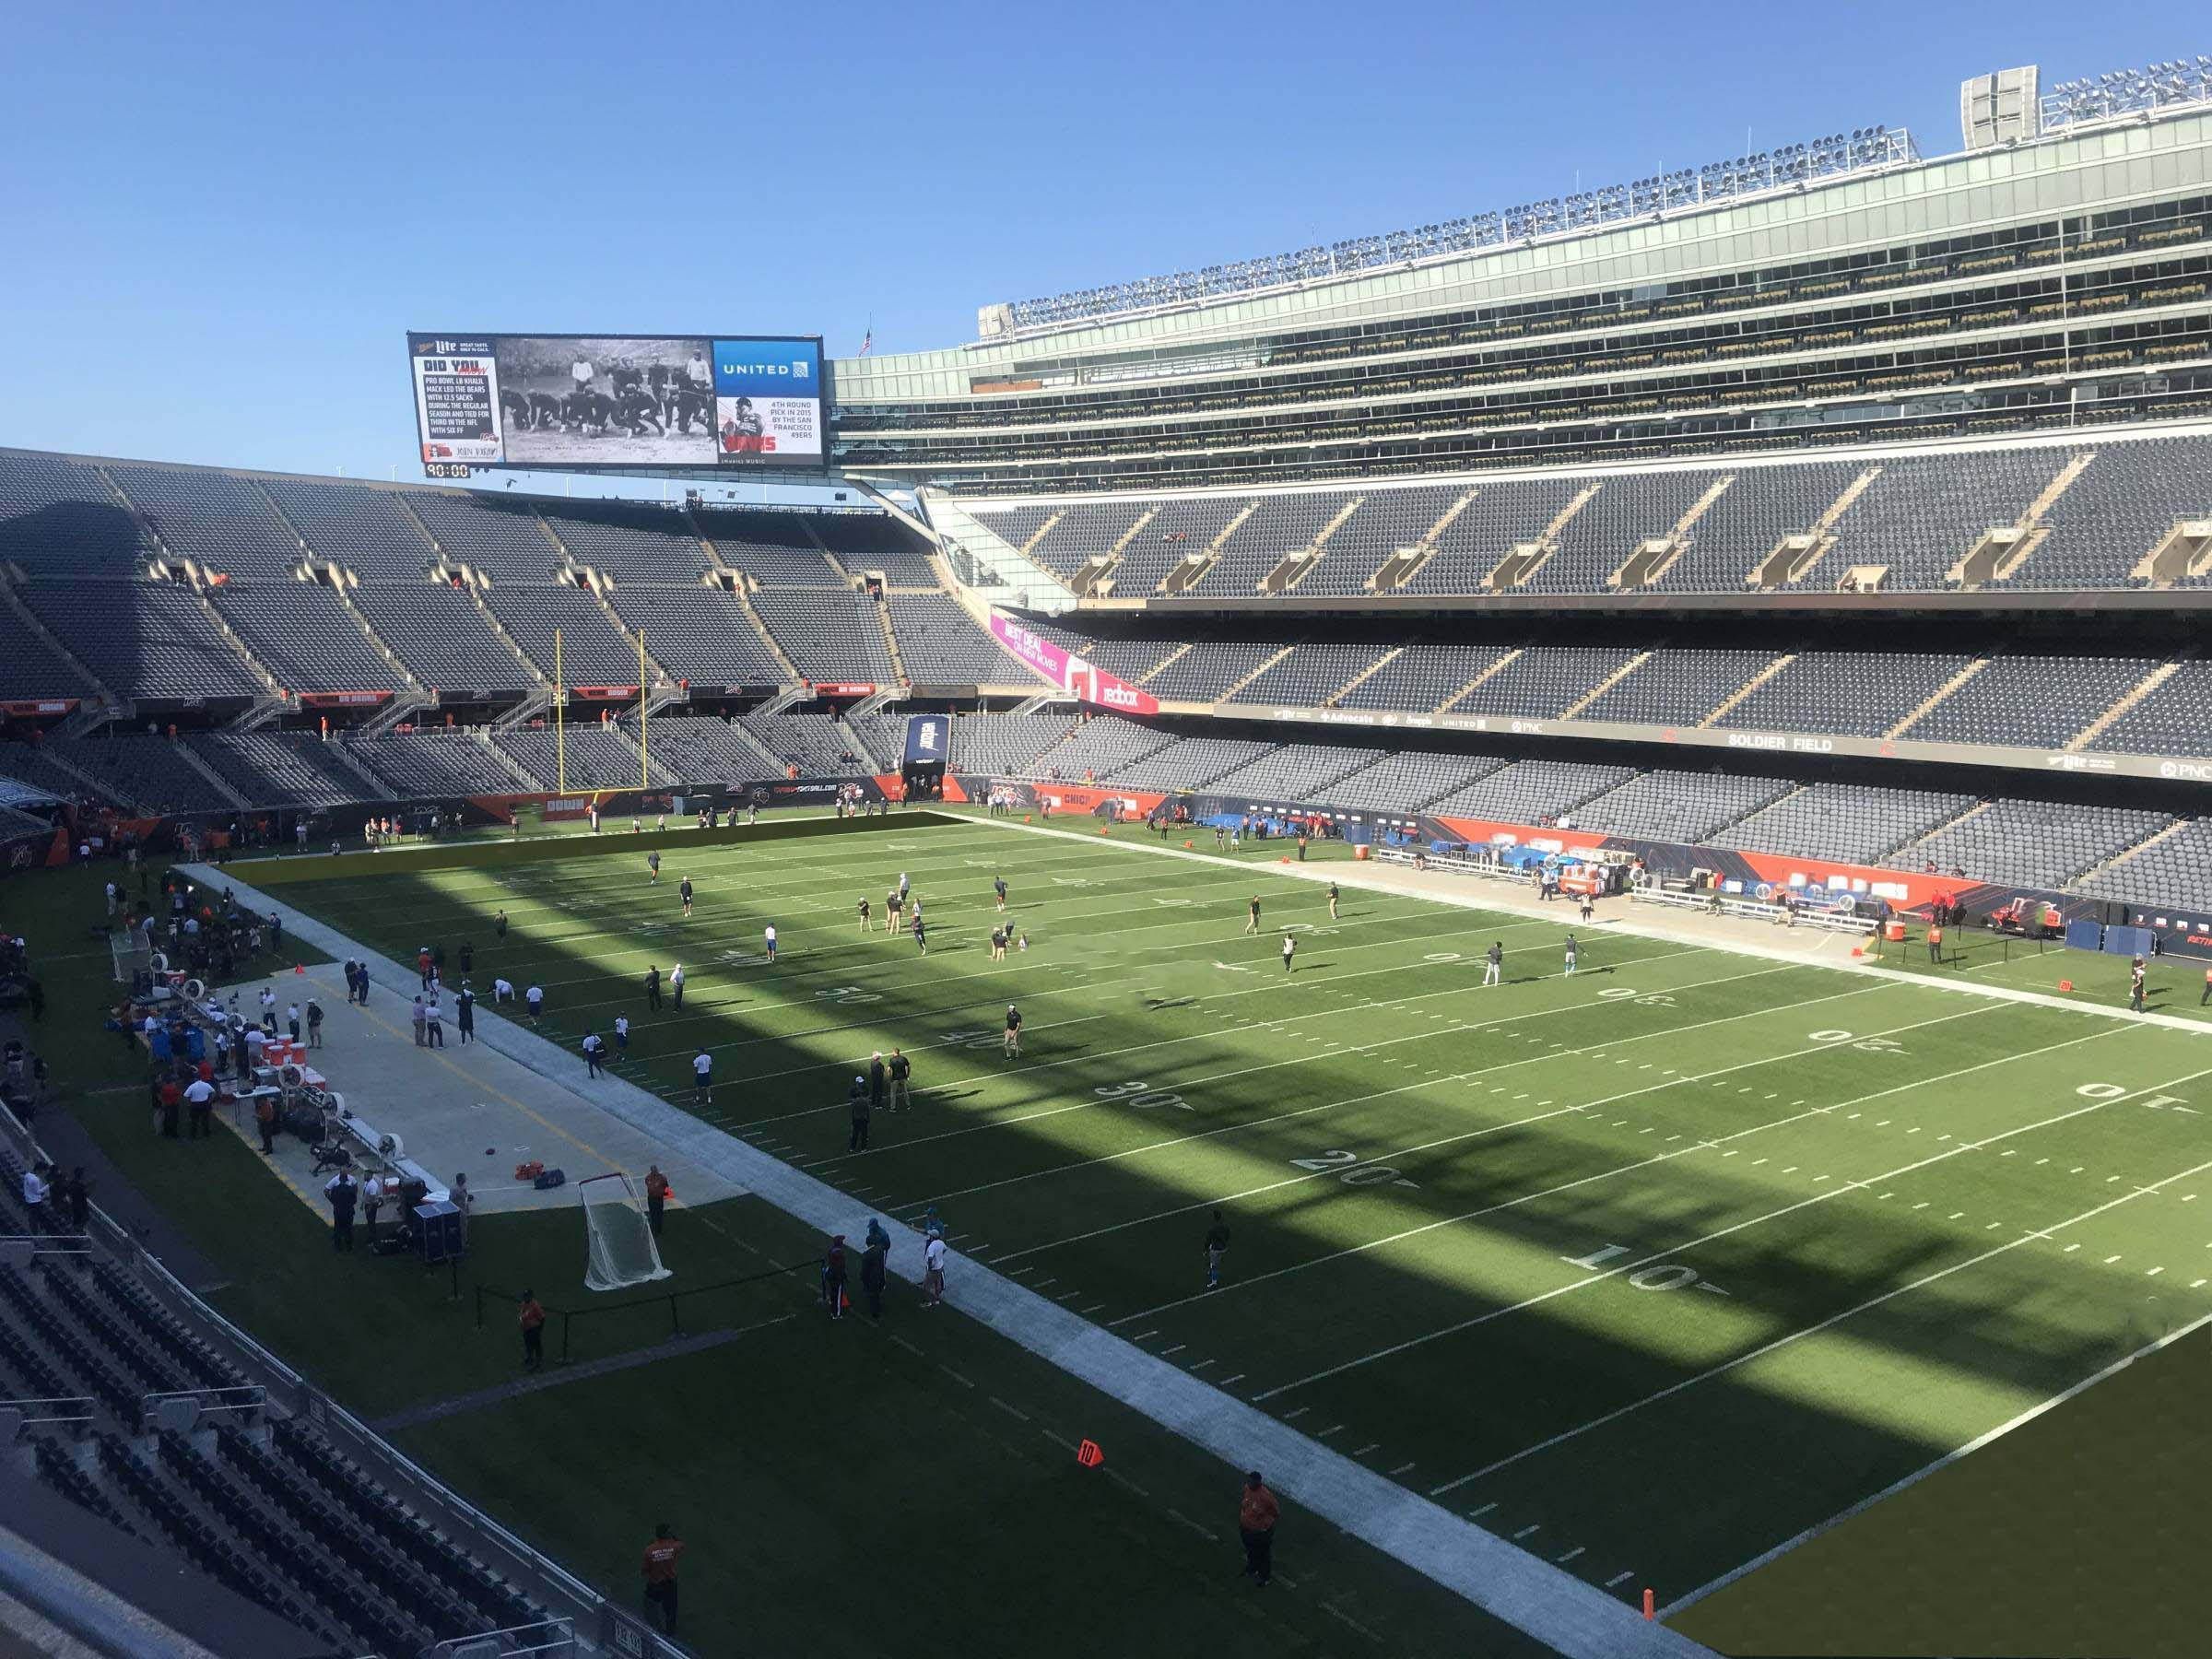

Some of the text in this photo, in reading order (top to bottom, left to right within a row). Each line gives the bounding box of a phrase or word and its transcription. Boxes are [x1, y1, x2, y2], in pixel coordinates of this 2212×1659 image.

[435, 340, 456, 354] Lite
[424, 360, 479, 371] DID YOU
[724, 364, 789, 375] UNITED
[427, 465, 468, 477] 90:00
[1005, 623, 1042, 652] BEST DEAL
[1014, 641, 1023, 652] ON
[1103, 684, 1138, 707] redbox
[1331, 712, 1374, 723] Advocate
[1442, 719, 1475, 728] UNITED
[1523, 723, 1543, 732] PNC
[1729, 735, 1832, 752] SOLDIER FIELD
[2179, 764, 2212, 778] PNC
[816, 986, 883, 1004] 50
[1808, 1030, 1902, 1052] 20
[1095, 1080, 1181, 1110] 30
[1290, 1150, 1400, 1187] 20
[1560, 1243, 1698, 1291] 10
[1081, 1443, 1094, 1464] 10
